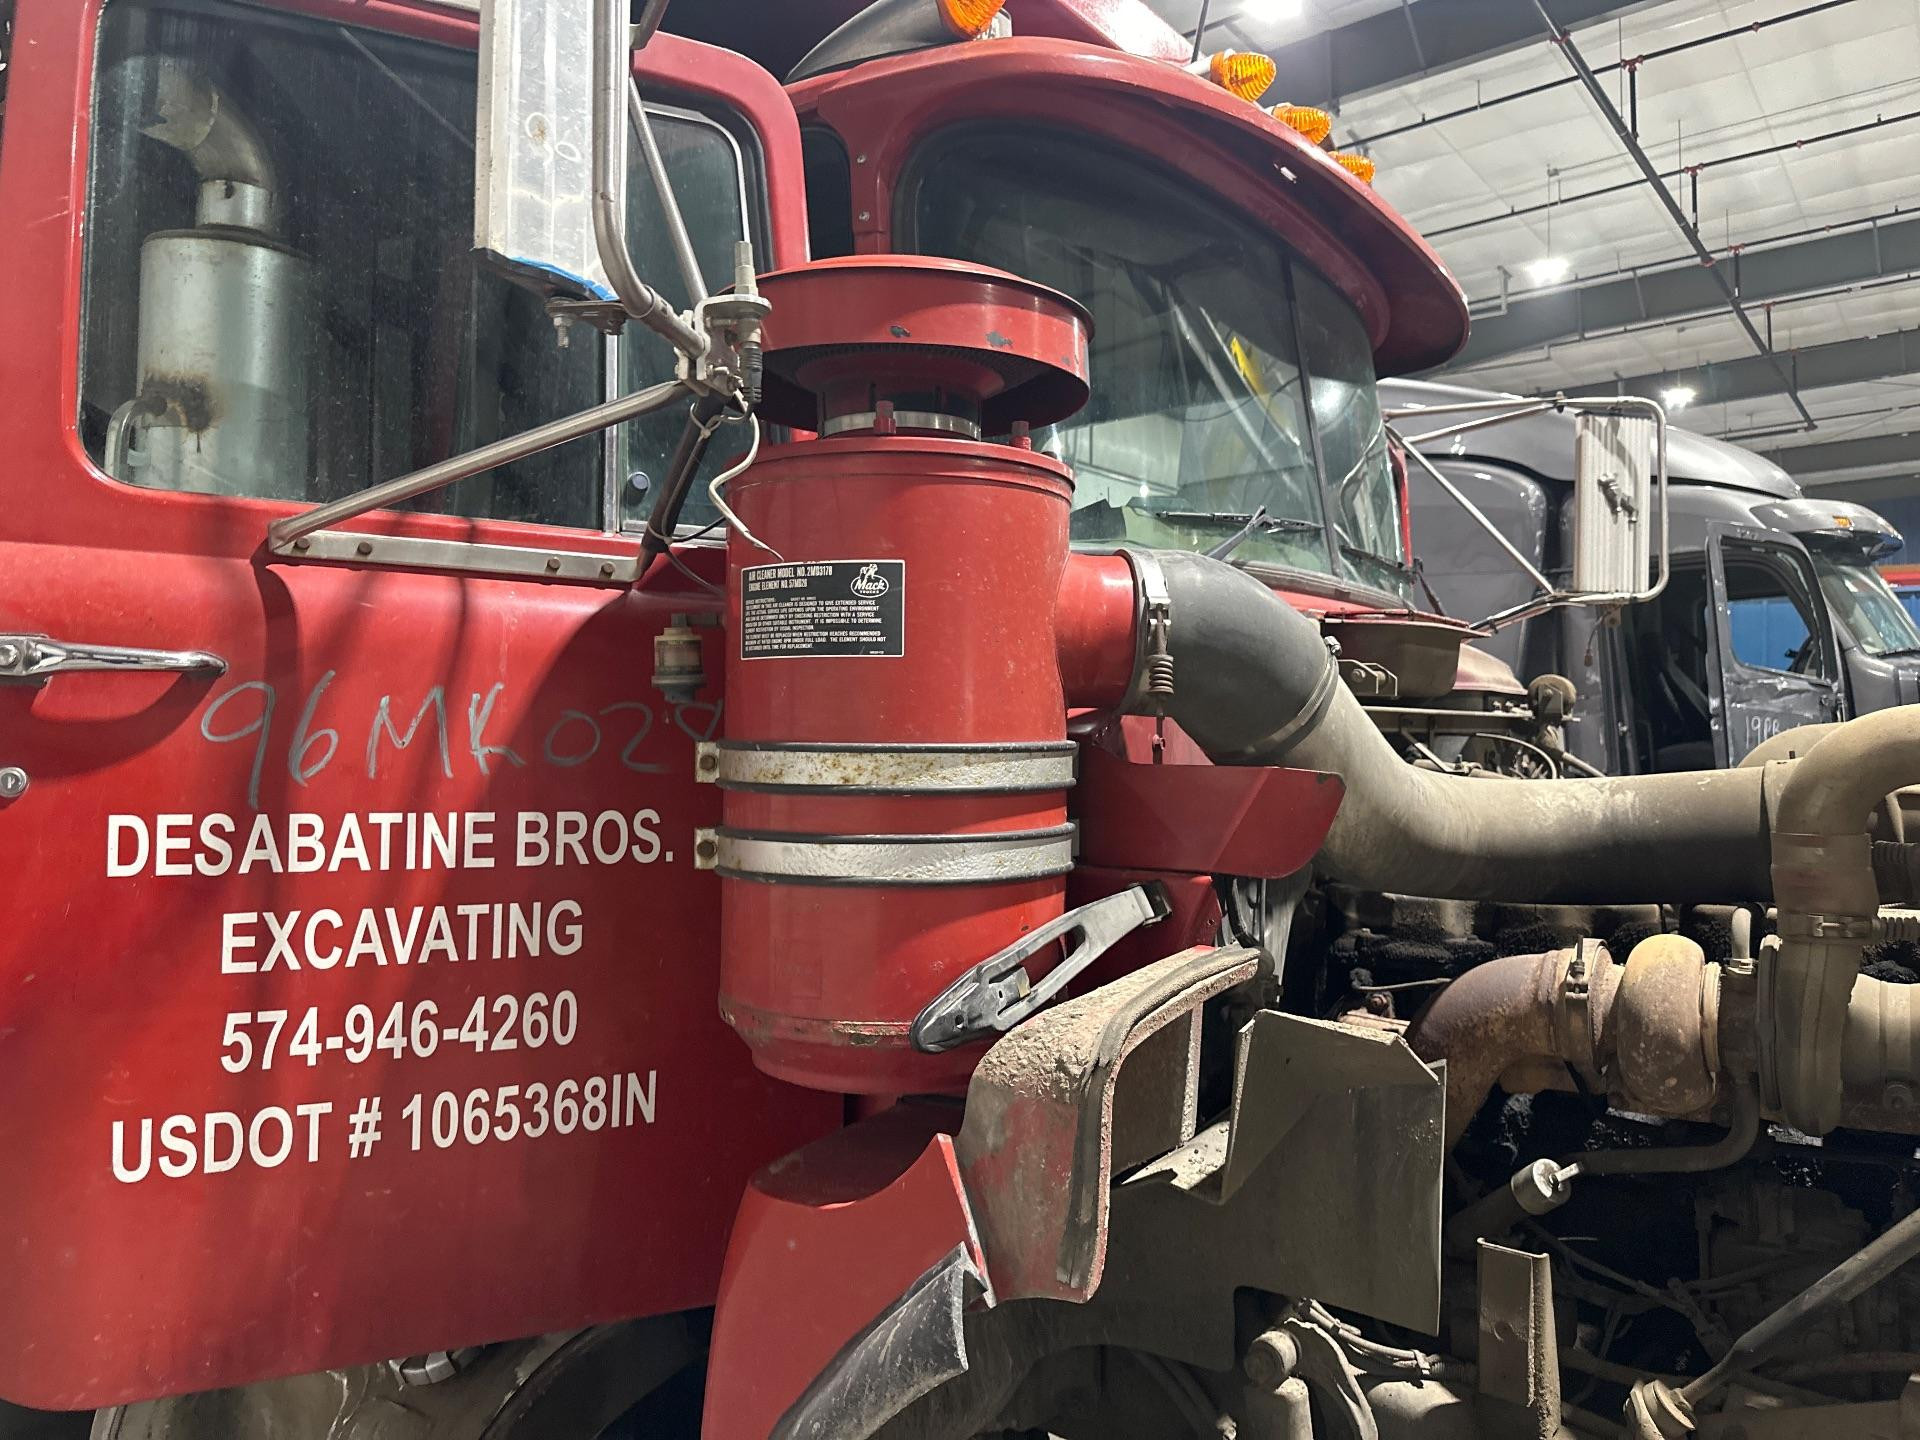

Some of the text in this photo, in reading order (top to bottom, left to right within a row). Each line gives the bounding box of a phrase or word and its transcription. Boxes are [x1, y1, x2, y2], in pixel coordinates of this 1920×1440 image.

[757, 569, 776, 580] CLEANER
[777, 567, 795, 578] MODEL
[854, 578, 886, 590] Mack
[107, 808, 674, 878] DESABATINE BROS.
[220, 900, 583, 974] EXCAVATING
[220, 990, 578, 1074] 574-946-4260
[112, 1070, 657, 1183] USDOT # 1065368IN
